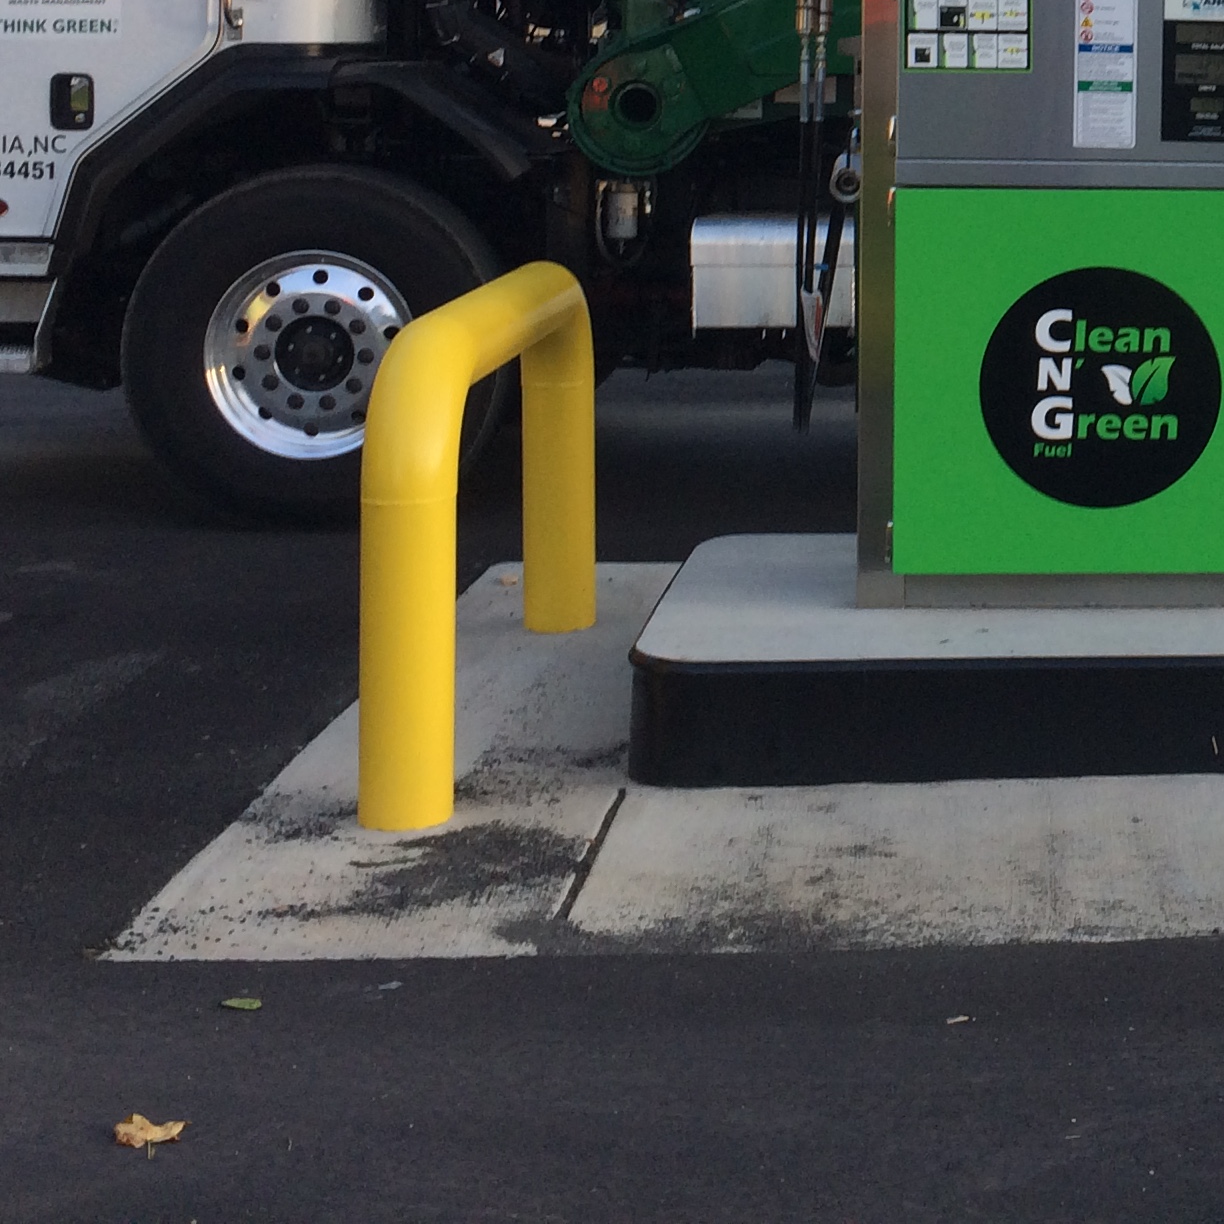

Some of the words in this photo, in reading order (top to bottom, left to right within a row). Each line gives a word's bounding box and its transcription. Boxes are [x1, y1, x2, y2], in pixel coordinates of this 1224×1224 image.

[0, 160, 55, 180] 4451
[1035, 308, 1171, 353] Clean
[1031, 396, 1179, 440] Green
[1033, 442, 1072, 458] Fuel
